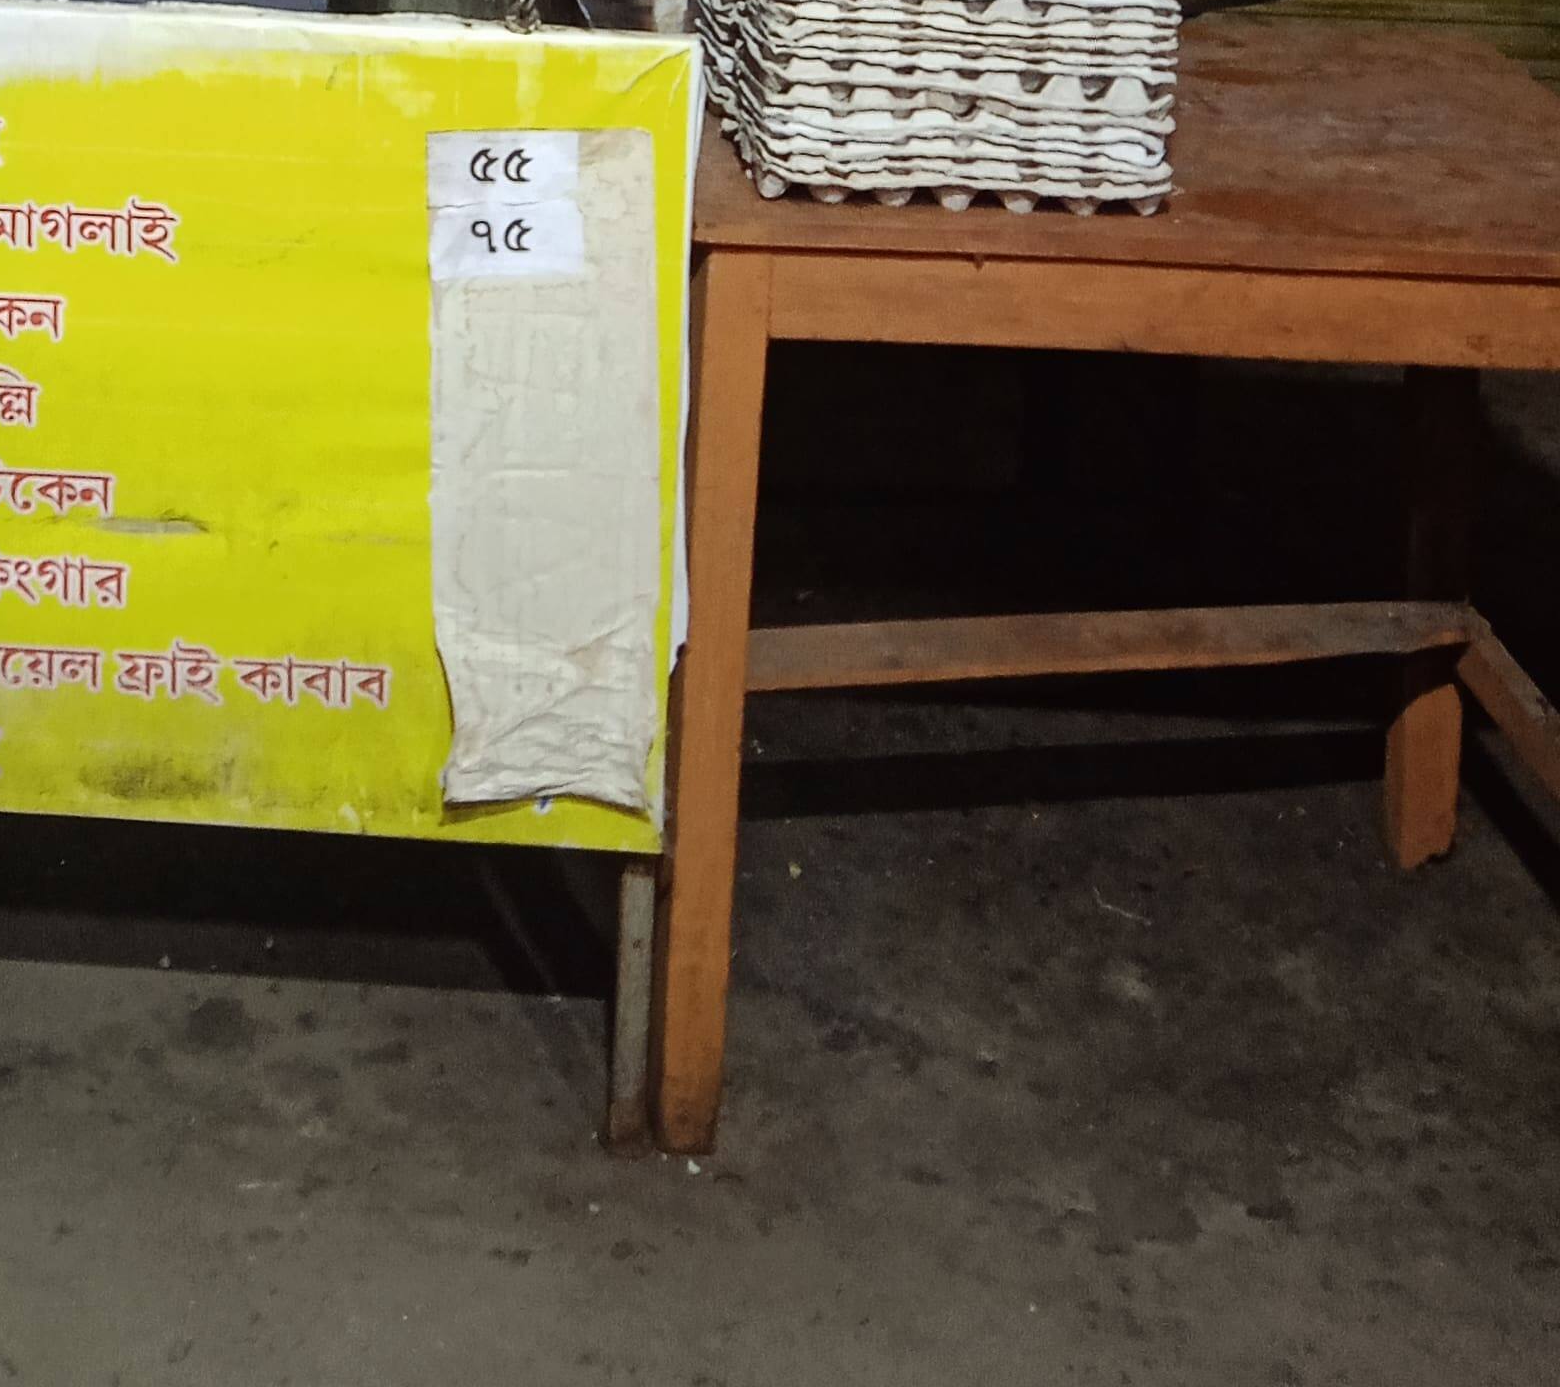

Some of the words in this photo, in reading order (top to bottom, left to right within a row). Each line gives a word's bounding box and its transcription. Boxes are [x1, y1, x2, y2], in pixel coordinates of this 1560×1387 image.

[470, 148, 533, 182] ৫৫
[471, 219, 532, 253] ৭৫
[116, 640, 220, 704] ফ্রাই
[235, 656, 391, 709] কাবাব
